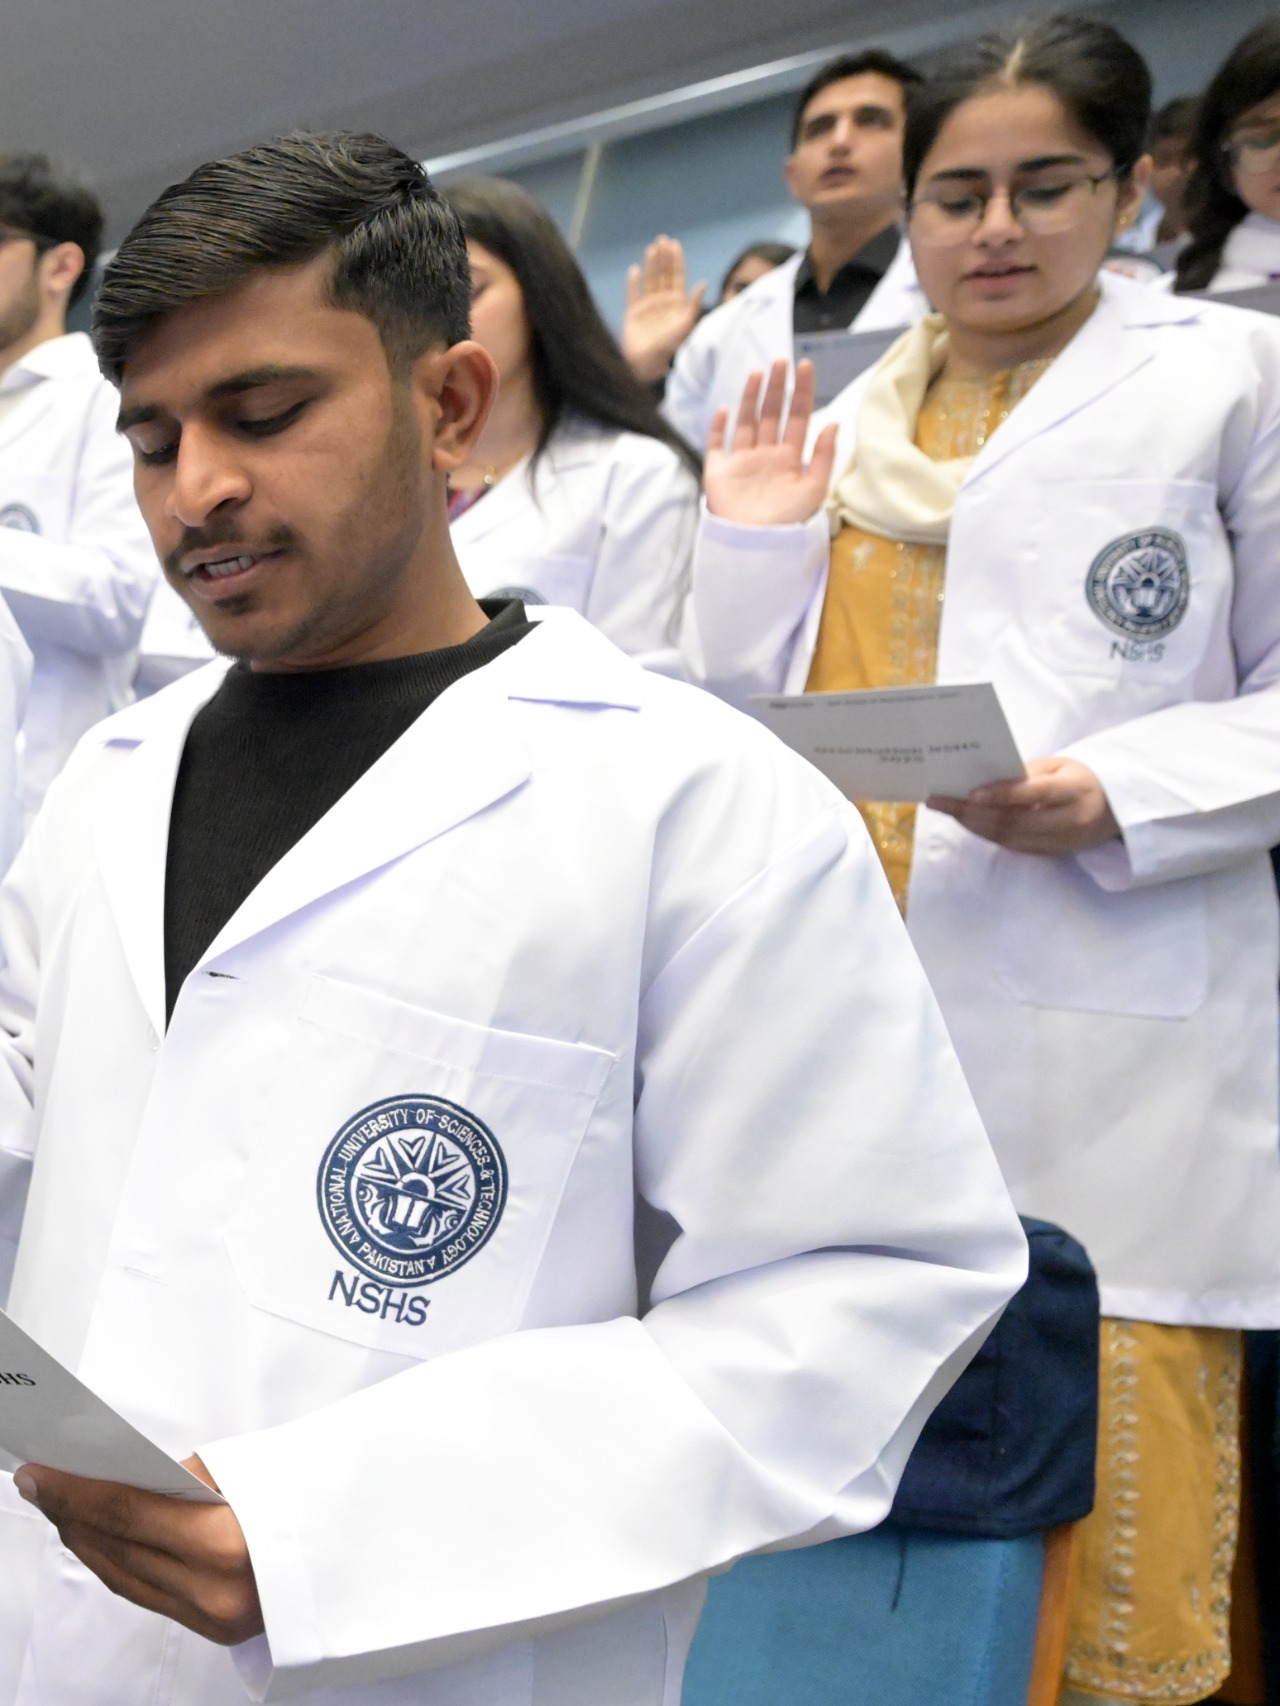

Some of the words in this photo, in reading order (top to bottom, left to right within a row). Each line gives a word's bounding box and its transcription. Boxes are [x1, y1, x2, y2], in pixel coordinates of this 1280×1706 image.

[338, 1108, 409, 1162] UNIVERSITY
[416, 1108, 436, 1124] OF
[438, 1114, 490, 1167] SCIENCES
[328, 1167, 354, 1236] NATIONAL
[441, 1180, 495, 1265] TECHNOLOGY
[357, 1243, 427, 1277] PAKISTAN
[327, 1269, 431, 1327] NSHS
